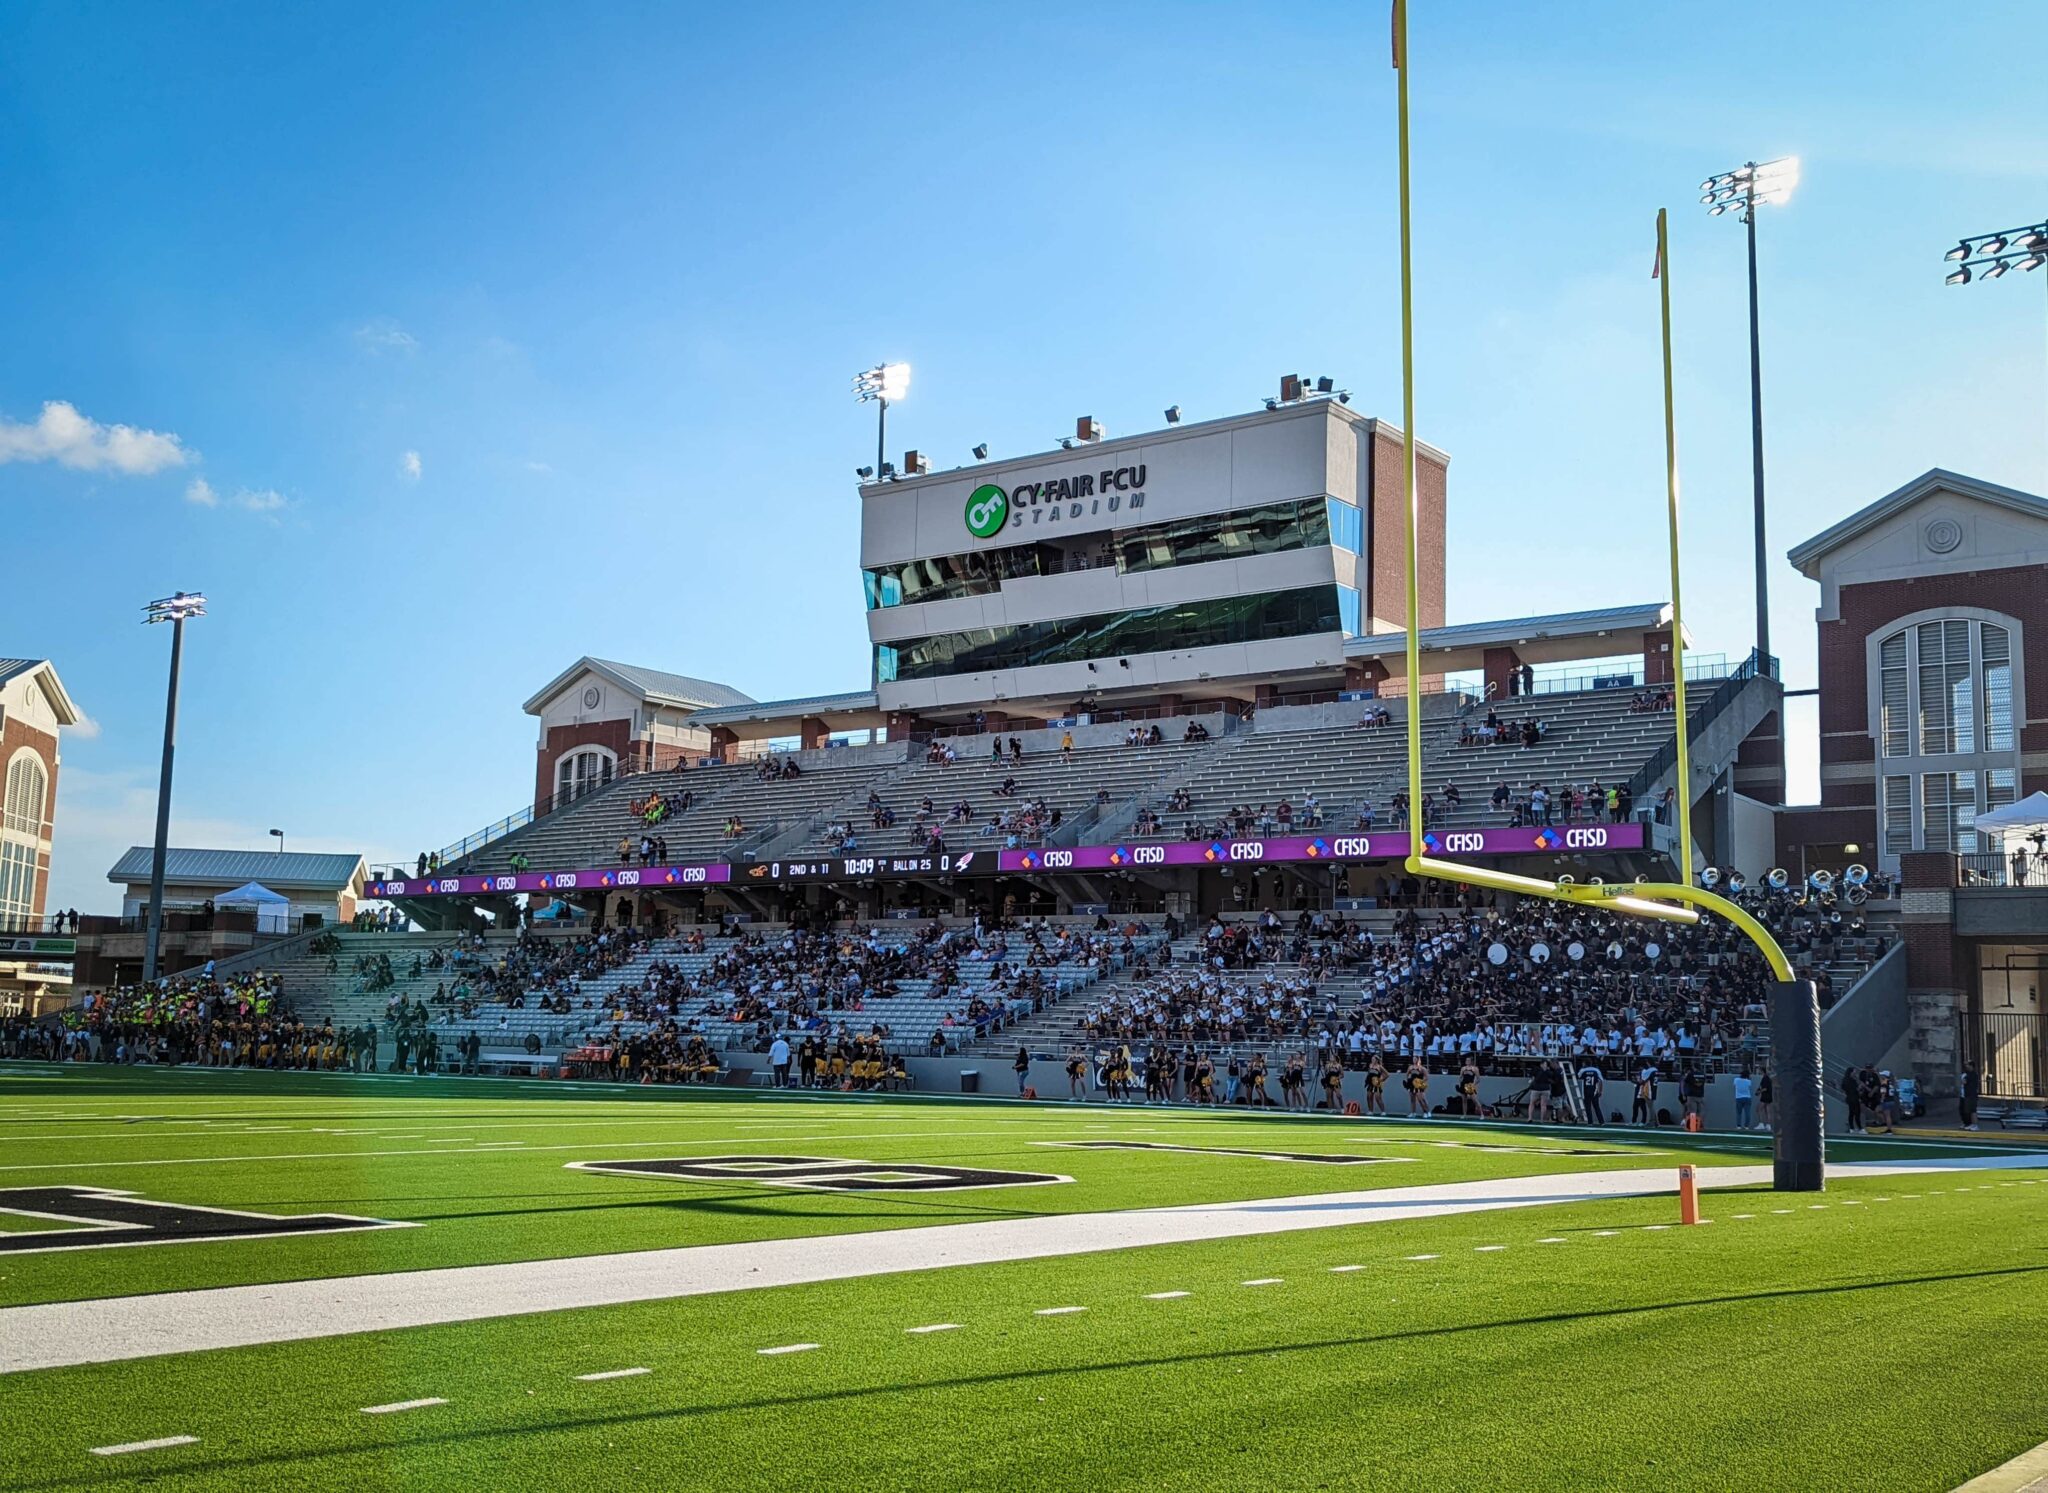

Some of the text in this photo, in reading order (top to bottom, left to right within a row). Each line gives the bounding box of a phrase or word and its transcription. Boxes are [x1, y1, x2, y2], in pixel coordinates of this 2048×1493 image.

[1099, 464, 1147, 493] FCU
[1011, 491, 1145, 528] STADIUM
[1607, 679, 1620, 688] AA
[1445, 833, 1484, 853] CFISD
[1565, 827, 1608, 849] CFISD
[1229, 842, 1264, 860] CFISD
[1333, 837, 1370, 857] CFISD
[1043, 850, 1073, 868] CFISD
[1133, 846, 1165, 864] CFISD
[771, 863, 780, 878] 0
[789, 863, 829, 875] 2ND & 11
[844, 859, 874, 875] 10:09
[893, 859, 931, 871] BALL ON 25
[941, 855, 949, 871] 0
[555, 873, 577, 888] CFISD
[617, 870, 640, 885] CFISD
[683, 867, 706, 882] CFISD
[386, 882, 405, 895] CFISD
[440, 879, 460, 892] CFISD
[496, 876, 516, 890] CFISD
[1602, 886, 1635, 897] Hellas
[1352, 901, 1358, 910] B
[1585, 1076, 1595, 1087] 21
[1345, 1101, 1358, 1114] 10
